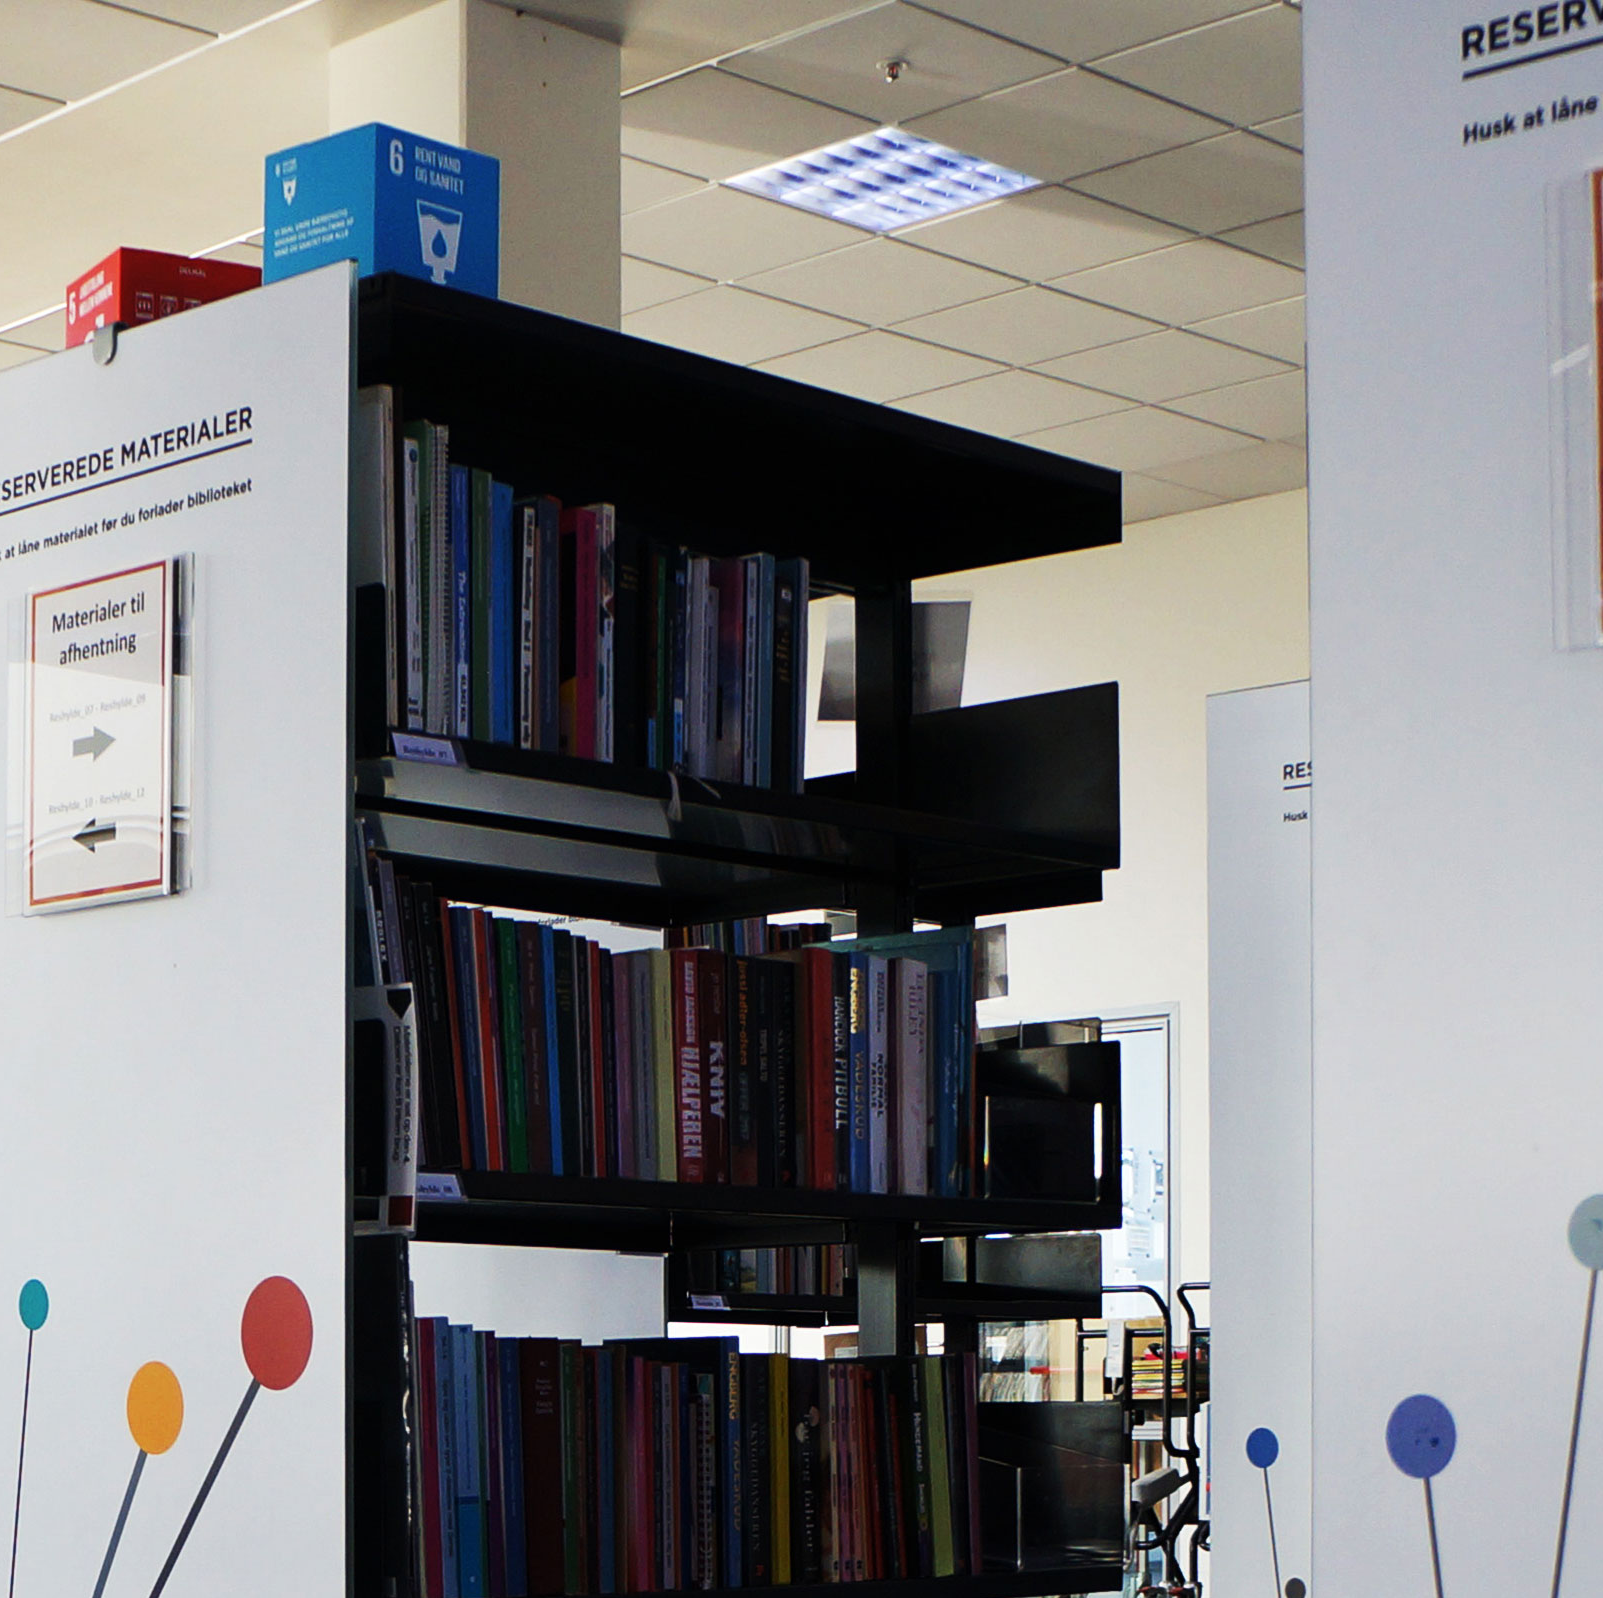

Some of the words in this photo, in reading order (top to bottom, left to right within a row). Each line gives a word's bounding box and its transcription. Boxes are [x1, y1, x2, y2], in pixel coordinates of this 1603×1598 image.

[1463, 112, 1515, 146] Husk
[1522, 105, 1544, 129] at
[1552, 95, 1598, 122] låne
[389, 139, 404, 176] 6
[415, 146, 437, 168] RENT
[121, 406, 253, 466] MATERIALER
[5, 545, 15, 559] at
[18, 539, 40, 556] låne
[43, 522, 98, 549] materialet
[101, 518, 117, 532] før
[120, 512, 135, 527] du
[138, 499, 184, 522] forlader
[187, 478, 252, 508] biblioteket
[52, 599, 126, 634] Materialer
[131, 590, 144, 614] til
[59, 632, 137, 666] afhentning
[1283, 810, 1308, 822] Husk
[737, 993, 750, 1065] adler-olsen
[834, 995, 846, 1051] HANCOCK
[681, 1046, 702, 1158] HJÆLPEREN
[708, 1040, 725, 1119] KNIV
[835, 1057, 848, 1129] PITBULL
[854, 1050, 866, 1140] VADESKUD
